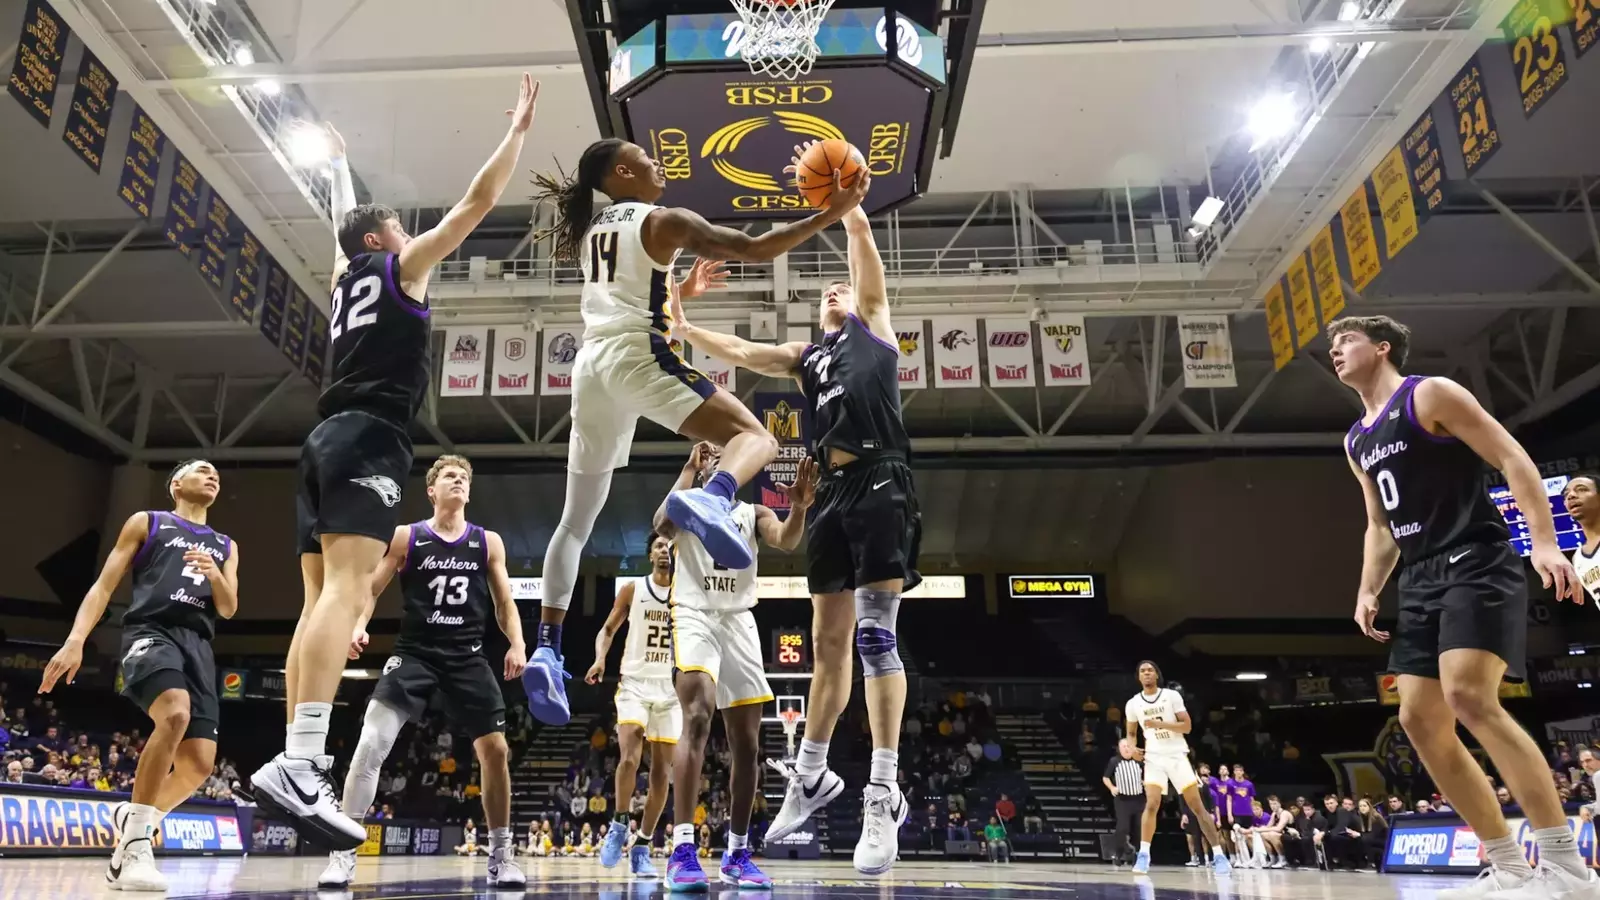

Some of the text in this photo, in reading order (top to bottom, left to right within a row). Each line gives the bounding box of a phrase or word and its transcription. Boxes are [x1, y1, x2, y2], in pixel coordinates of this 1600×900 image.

[1513, 16, 1558, 93] 23
[726, 85, 833, 106] CFSB
[1460, 96, 1490, 153] 24
[658, 128, 691, 180] CFSB
[868, 122, 901, 176] CFSB
[590, 231, 619, 283] 14
[330, 275, 382, 345] 22
[991, 332, 1029, 346] UIC
[1043, 325, 1082, 337] VALPO
[776, 446, 807, 459] CERS
[769, 472, 797, 482] STATE
[1376, 469, 1400, 511] 0
[165, 536, 225, 561] Northern
[417, 555, 480, 571] Northern
[427, 575, 470, 606] 13
[704, 575, 737, 594] STATE
[1028, 581, 1062, 592] MEGA
[426, 609, 465, 625] Iowa
[643, 609, 670, 622] MURR
[646, 625, 670, 649] 22
[779, 645, 800, 663] 26
[2, 797, 114, 848] RACERS
[1392, 833, 1448, 855] KOPPERUD
